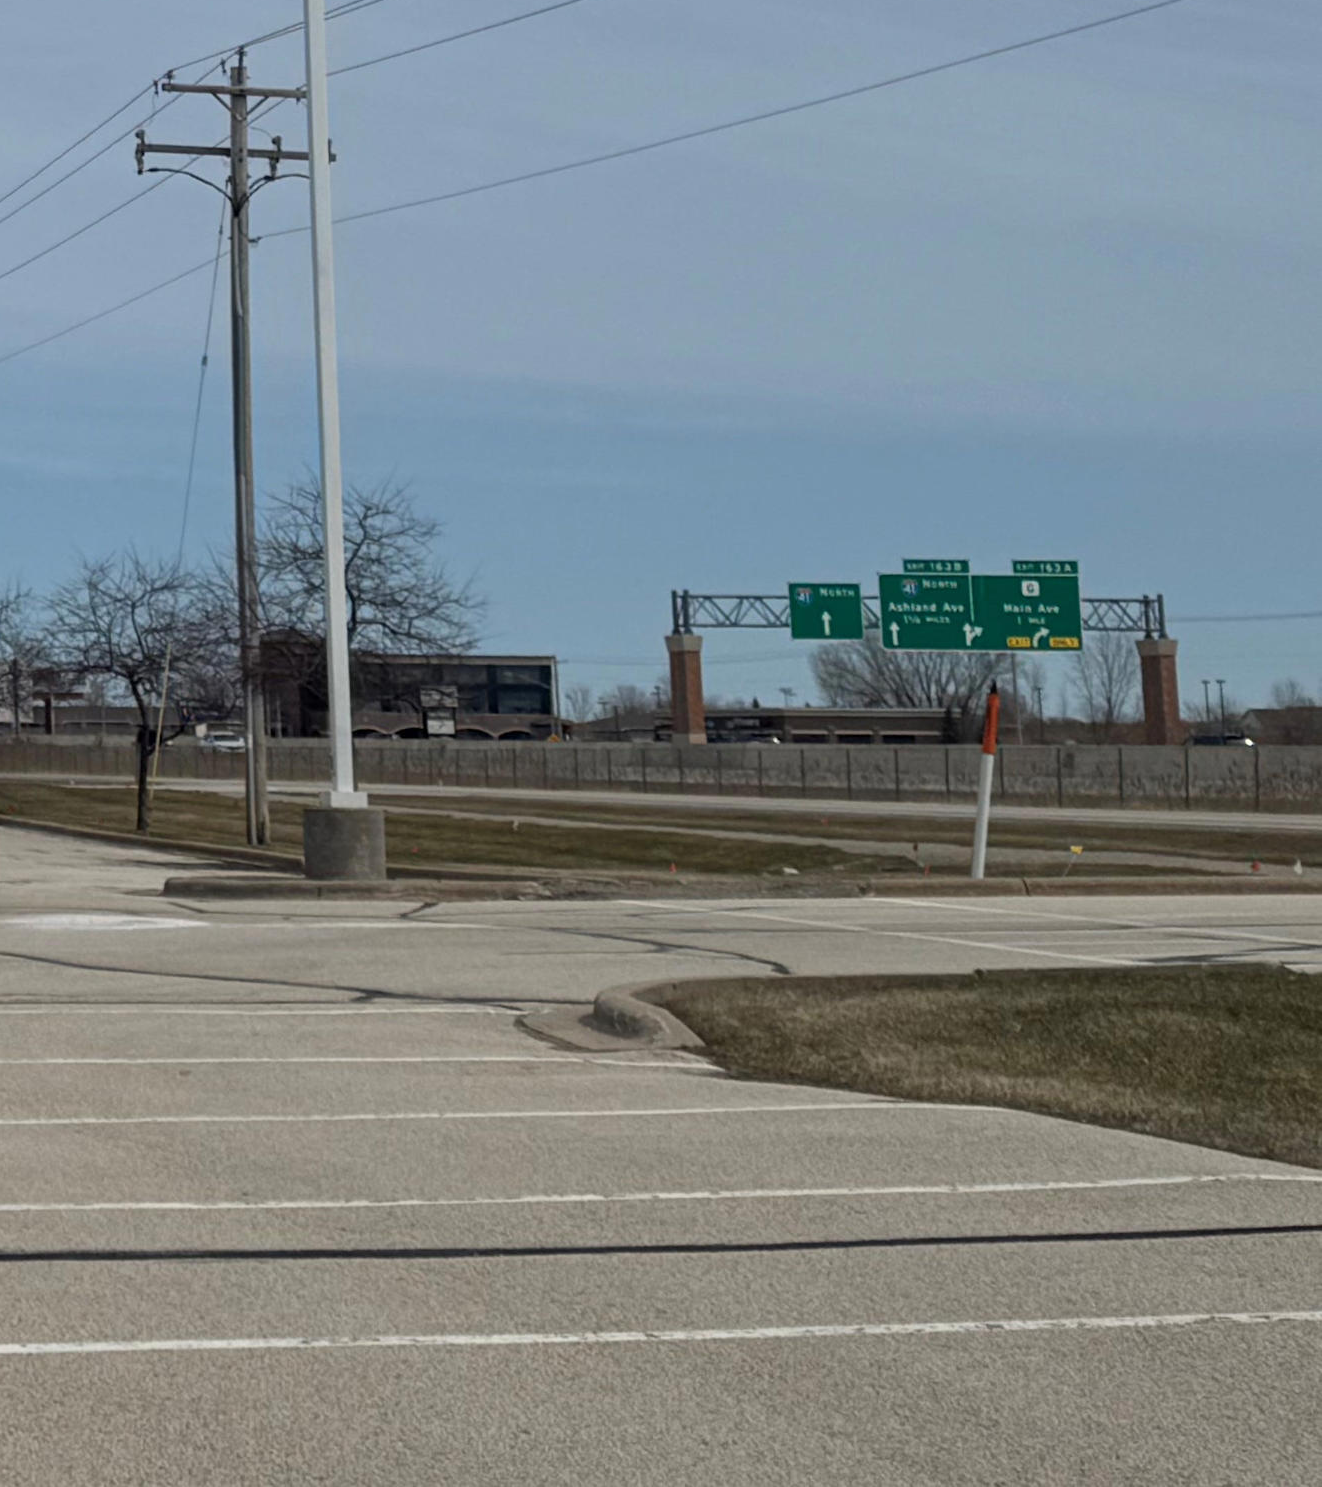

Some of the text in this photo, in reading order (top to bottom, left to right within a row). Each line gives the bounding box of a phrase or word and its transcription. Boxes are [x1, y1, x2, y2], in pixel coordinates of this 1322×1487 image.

[819, 588, 856, 598] NORTH
[888, 602, 965, 613] Ashland Ave
[1003, 603, 1060, 615] Main Ave
